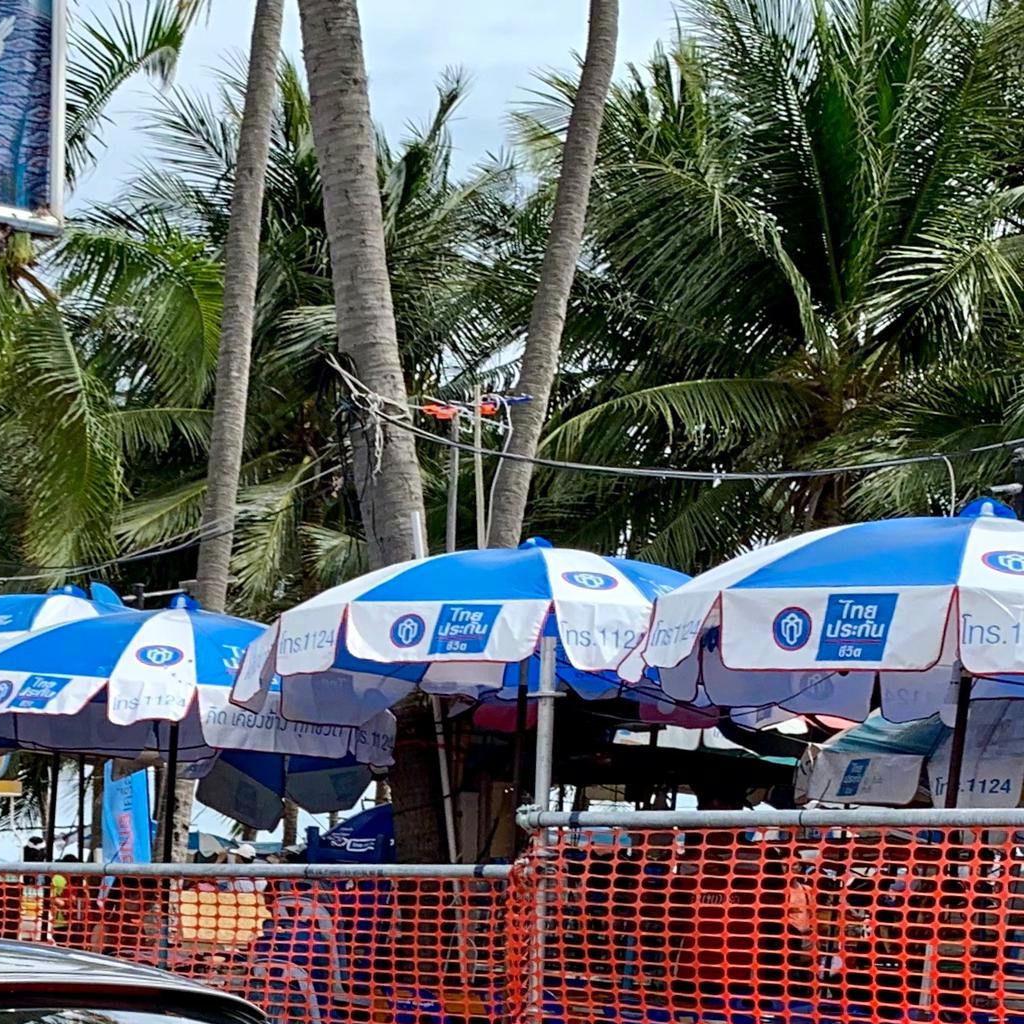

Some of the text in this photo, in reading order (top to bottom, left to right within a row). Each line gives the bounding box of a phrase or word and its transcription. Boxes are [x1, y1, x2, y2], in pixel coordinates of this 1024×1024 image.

[450, 607, 484, 622] ไทย
[838, 599, 878, 619] ไทย
[438, 621, 488, 636] ประกัน
[560, 620, 636, 649] โทร.112
[826, 620, 885, 638] ประกัน
[838, 644, 863, 657] ชีวิต
